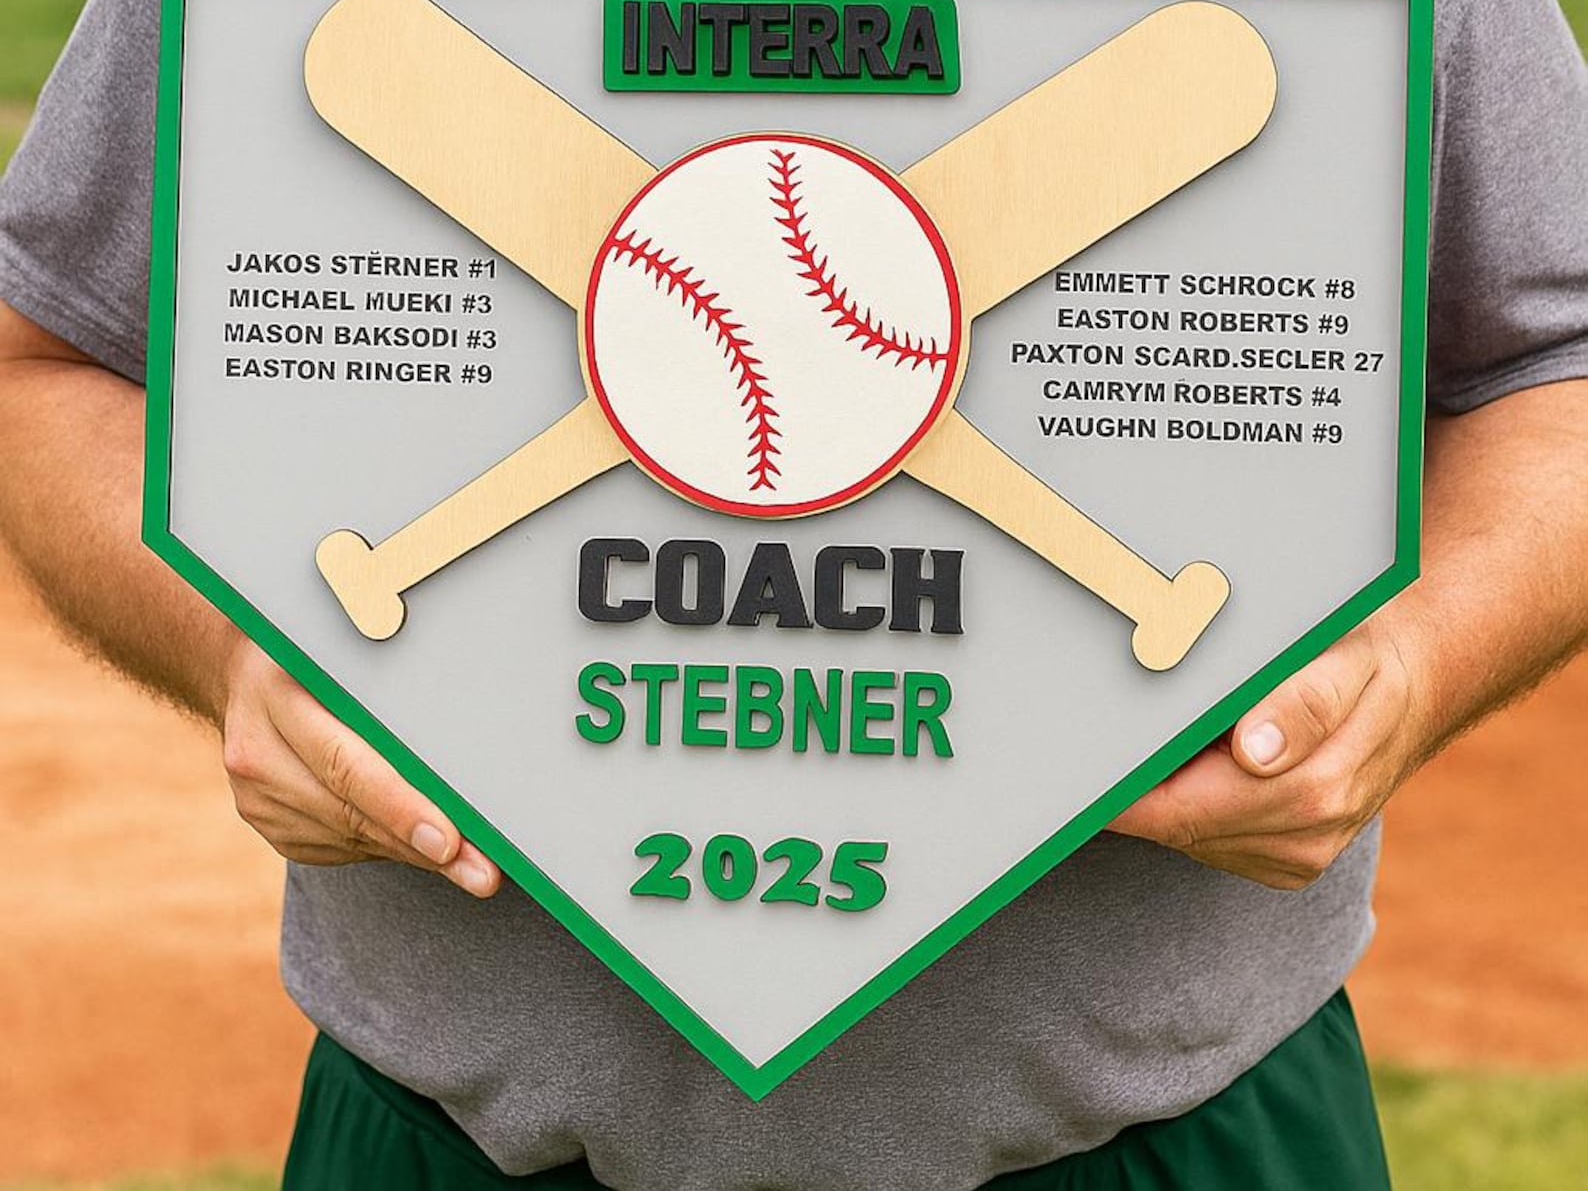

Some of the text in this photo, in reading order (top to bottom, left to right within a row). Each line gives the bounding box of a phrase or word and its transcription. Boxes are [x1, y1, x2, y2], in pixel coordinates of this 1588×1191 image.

[621, 0, 945, 80] INTERRA
[226, 253, 321, 274] JAKOS
[468, 258, 495, 279] #1
[1053, 270, 1355, 300] EMMETT SCHROCK #8
[229, 288, 492, 314] MICHAEL MUEKI #3
[1057, 308, 1349, 335] EASTON ROBERTS #9
[224, 323, 497, 350] MASON BAKSODI #3
[226, 358, 492, 384] EASTON RINGER #9
[1011, 343, 1123, 365] PAXTON
[1354, 352, 1384, 373] 27
[1043, 380, 1342, 407] CAMRYM ROBERTS #4
[1037, 416, 1343, 444] VAUGHN BOLDMAN #9
[577, 538, 966, 635] COACH
[575, 661, 955, 758] STEBNER
[629, 832, 890, 913] 2025
